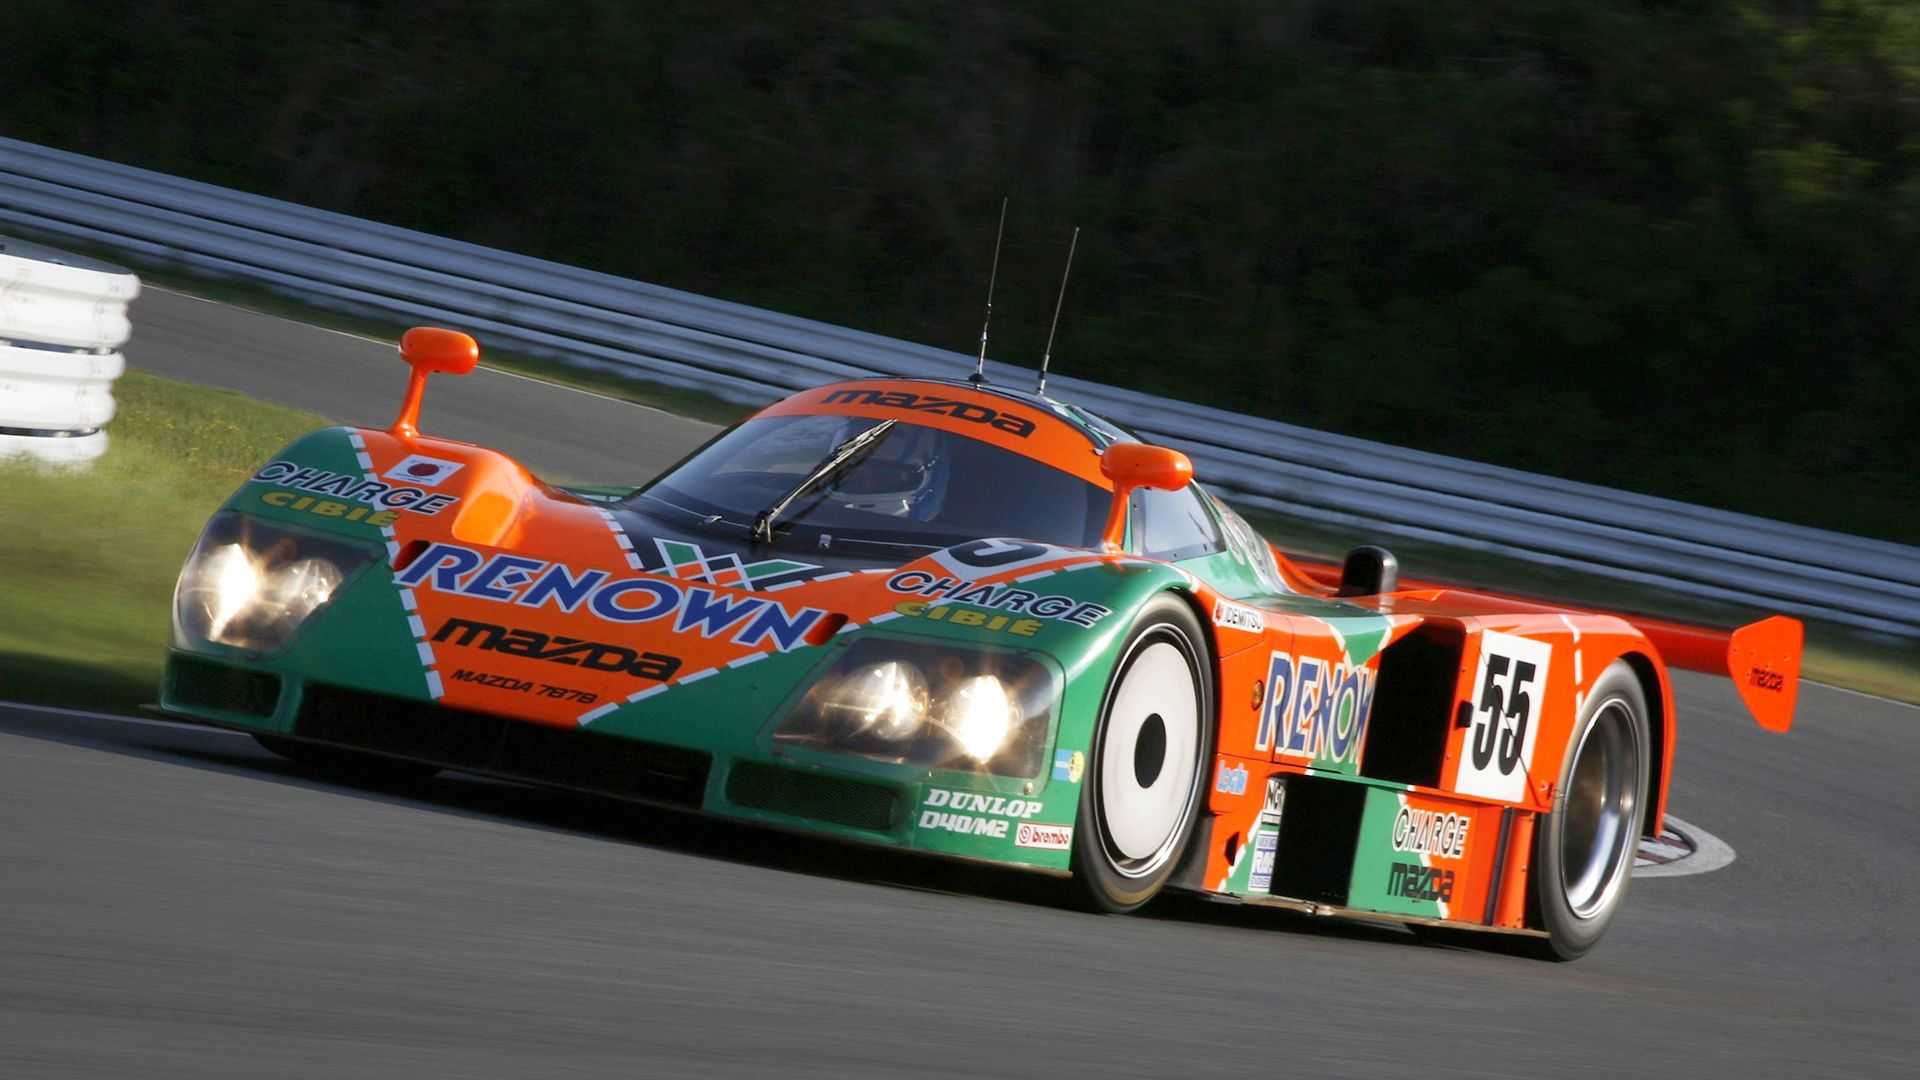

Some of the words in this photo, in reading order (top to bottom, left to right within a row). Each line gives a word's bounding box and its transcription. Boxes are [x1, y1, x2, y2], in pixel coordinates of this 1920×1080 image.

[252, 461, 460, 516] CHARGE
[399, 542, 827, 653] RENOWN
[885, 570, 1112, 629] CHARGE
[450, 669, 533, 693] MAZDA
[1472, 653, 1536, 776] 55
[919, 811, 1009, 838] D40/M2
[923, 788, 1043, 818] DUNLOP
[1032, 827, 1069, 845] brembo
[1392, 808, 1470, 859] CHARGE
